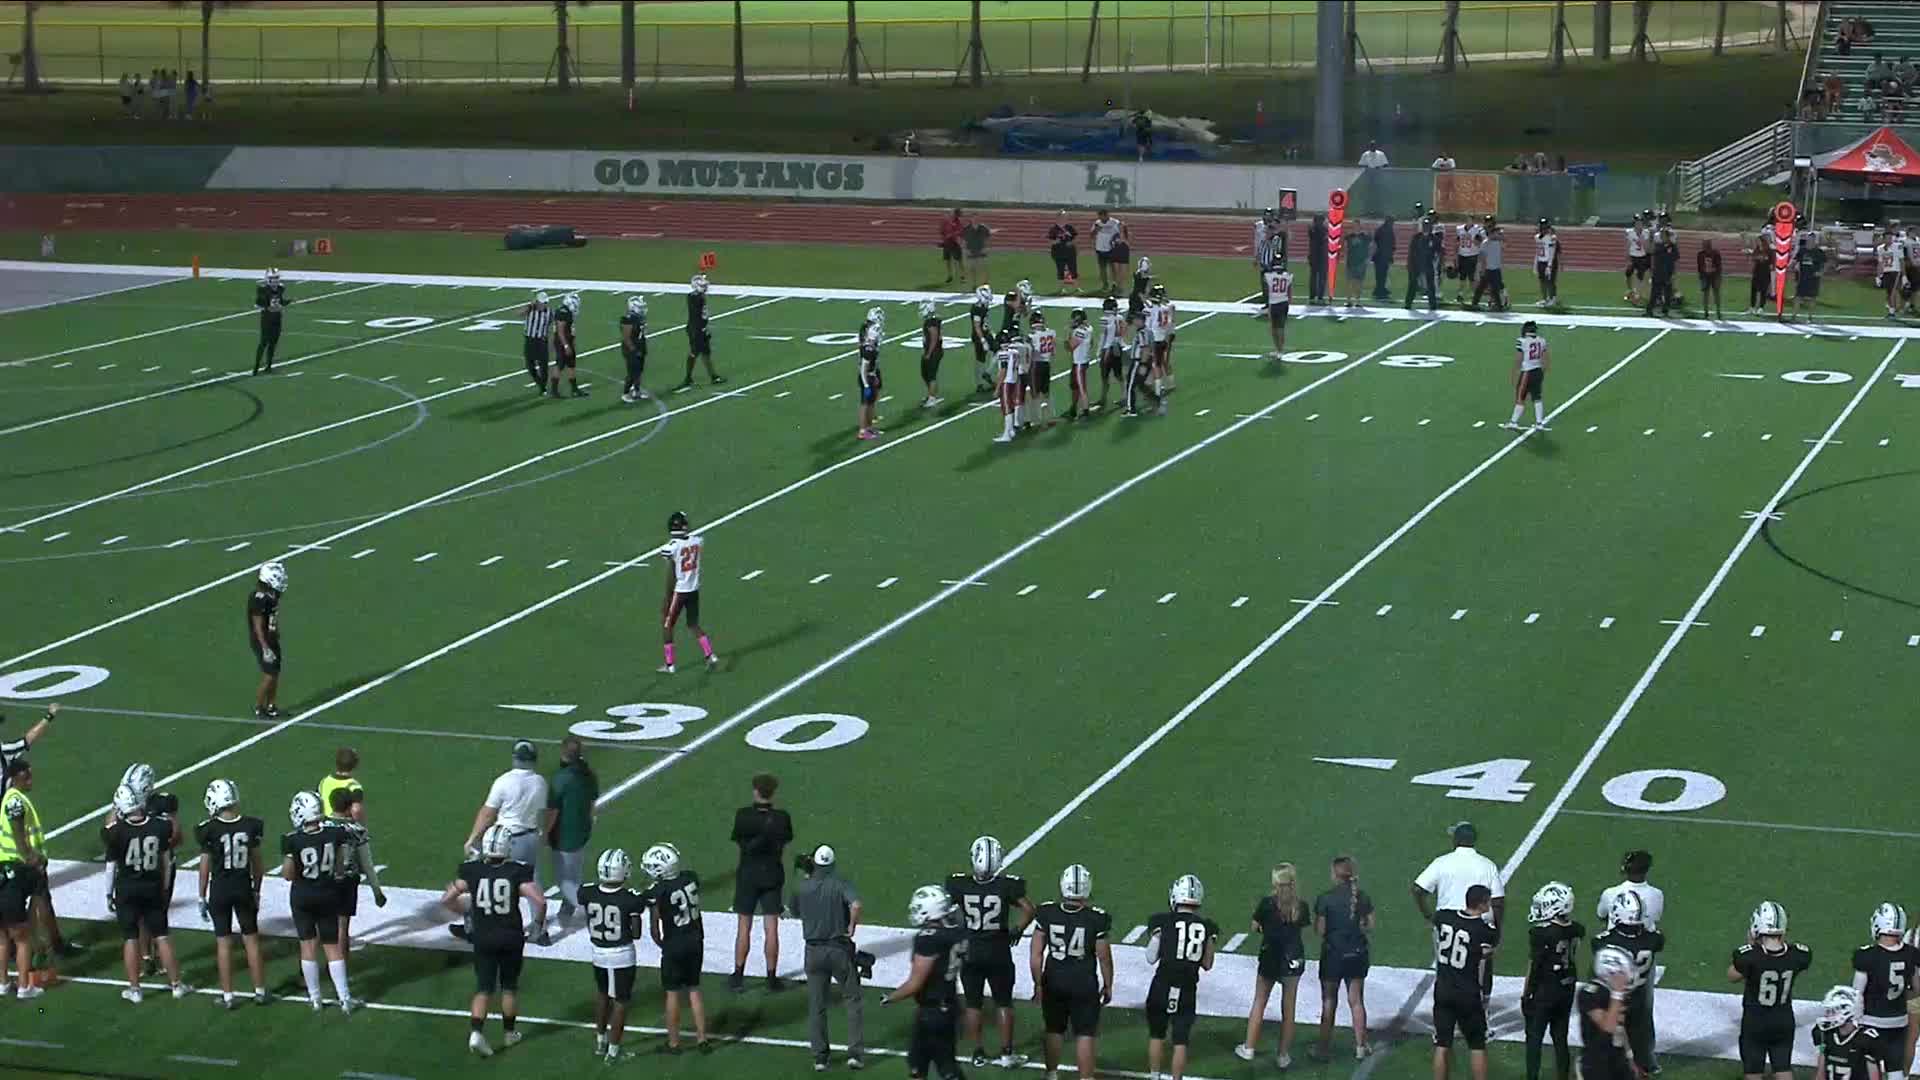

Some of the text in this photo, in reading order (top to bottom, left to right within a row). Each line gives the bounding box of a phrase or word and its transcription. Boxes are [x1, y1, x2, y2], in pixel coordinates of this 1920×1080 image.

[594, 159, 864, 191] GO MUSTANGS
[1281, 191, 1294, 209] 4
[1272, 278, 1287, 293] 20
[1040, 336, 1055, 353] 22
[1529, 343, 1541, 360] 21
[670, 545, 688, 573] 27
[125, 836, 159, 872] 48
[220, 832, 248, 870] 16
[300, 843, 334, 879] 84
[476, 878, 511, 915] 49
[670, 882, 699, 927] 35
[963, 894, 1001, 931] 52
[587, 903, 621, 941] 29
[1048, 924, 1085, 961] 54
[1175, 921, 1206, 963] 18
[1437, 923, 1470, 970] 26
[1758, 969, 1793, 1006] 61
[1888, 961, 1906, 1001] 5
